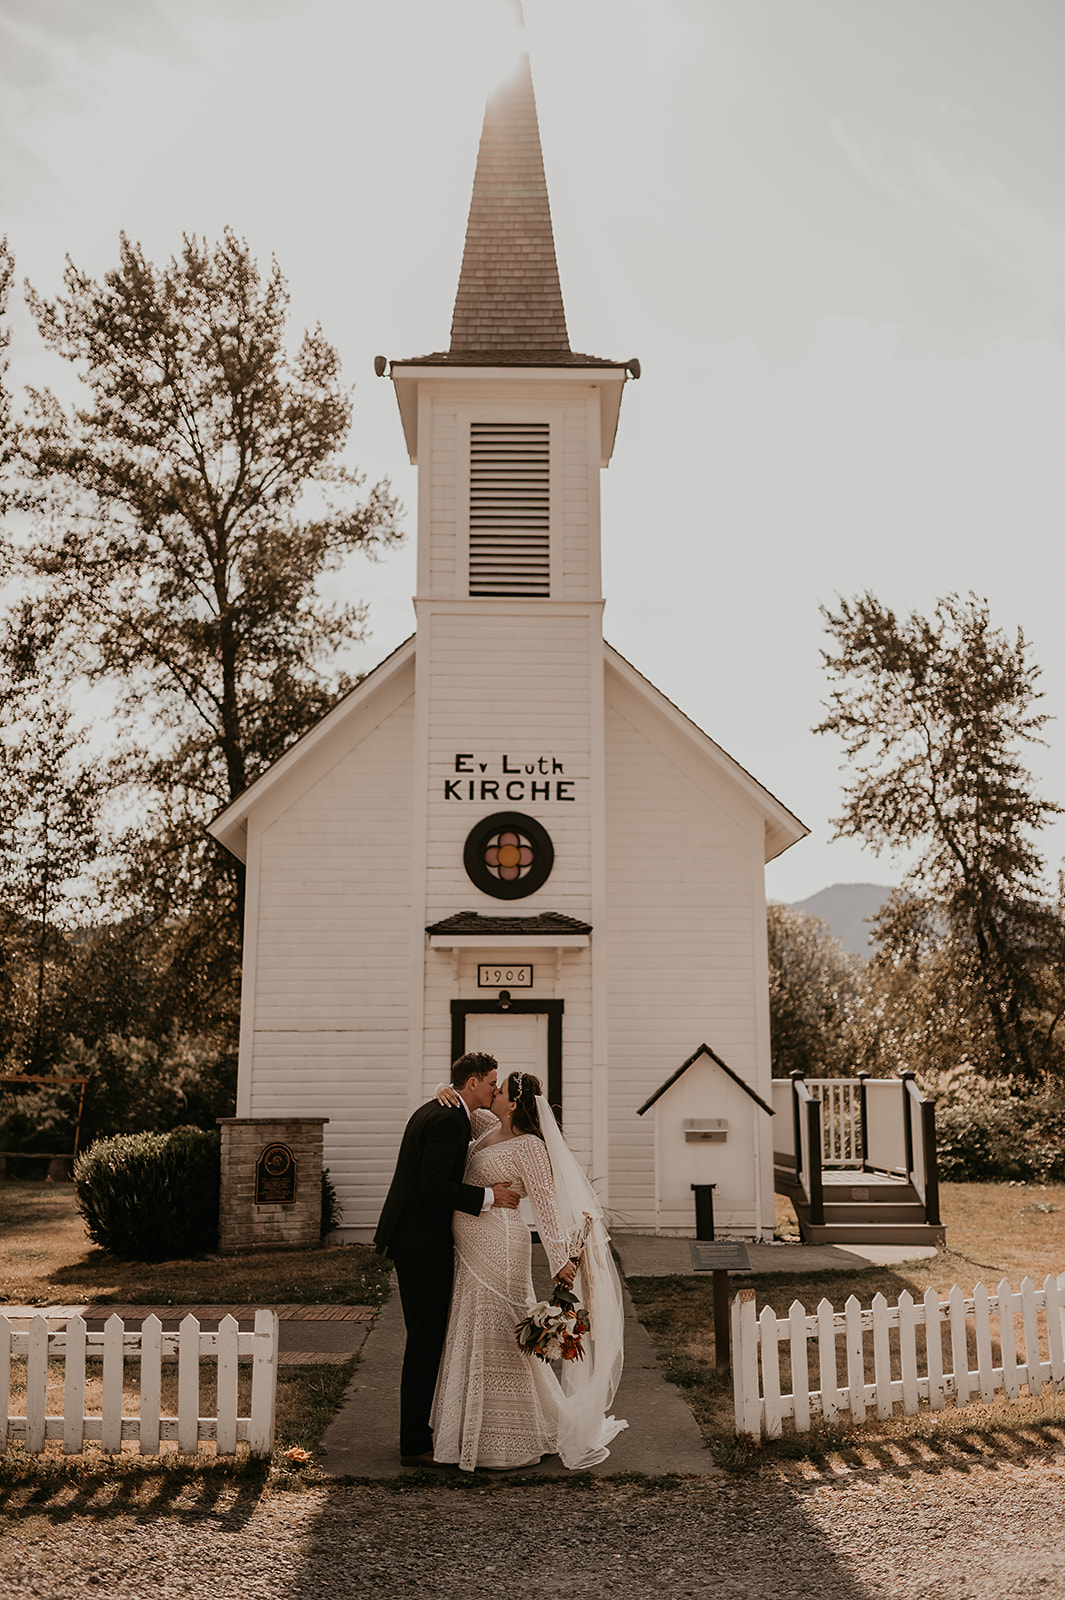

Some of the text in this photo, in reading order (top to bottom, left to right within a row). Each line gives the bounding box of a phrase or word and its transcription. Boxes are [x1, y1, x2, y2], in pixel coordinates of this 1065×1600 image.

[455, 754, 564, 775] Ev Luth
[444, 780, 575, 801] KIRCHE
[485, 969, 525, 983] 1906
